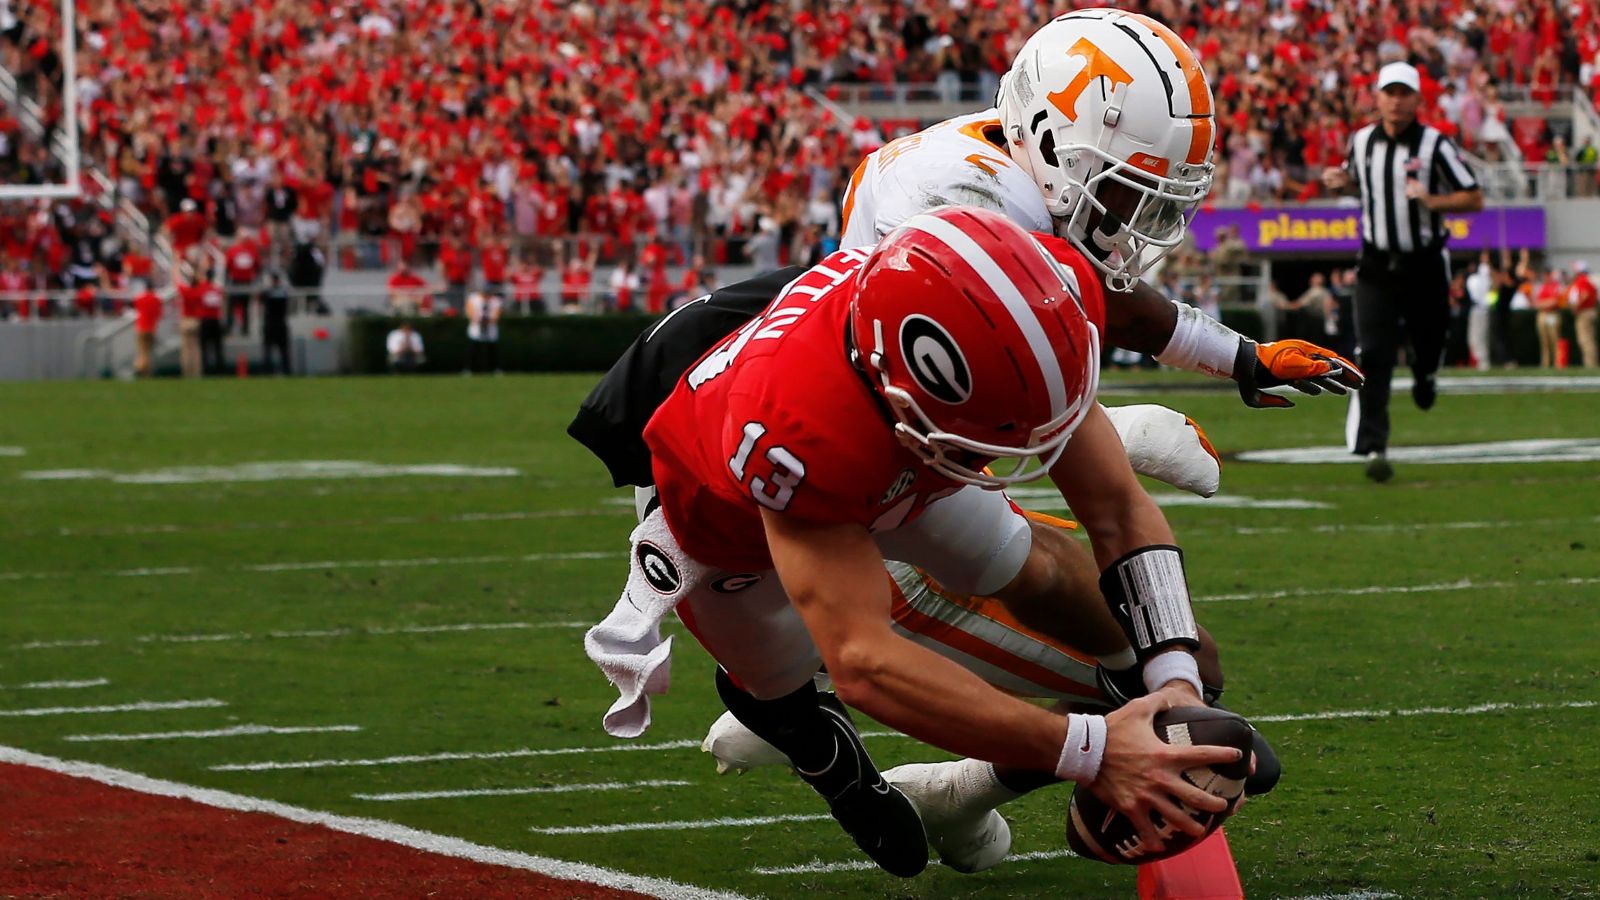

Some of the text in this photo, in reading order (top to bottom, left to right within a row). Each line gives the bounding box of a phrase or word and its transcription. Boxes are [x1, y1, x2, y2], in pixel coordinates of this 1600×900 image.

[1046, 36, 1134, 123] T
[1258, 212, 1358, 246] planet
[910, 330, 970, 403] G
[728, 421, 806, 512] 13
[643, 552, 680, 587] G
[719, 574, 761, 591] G
